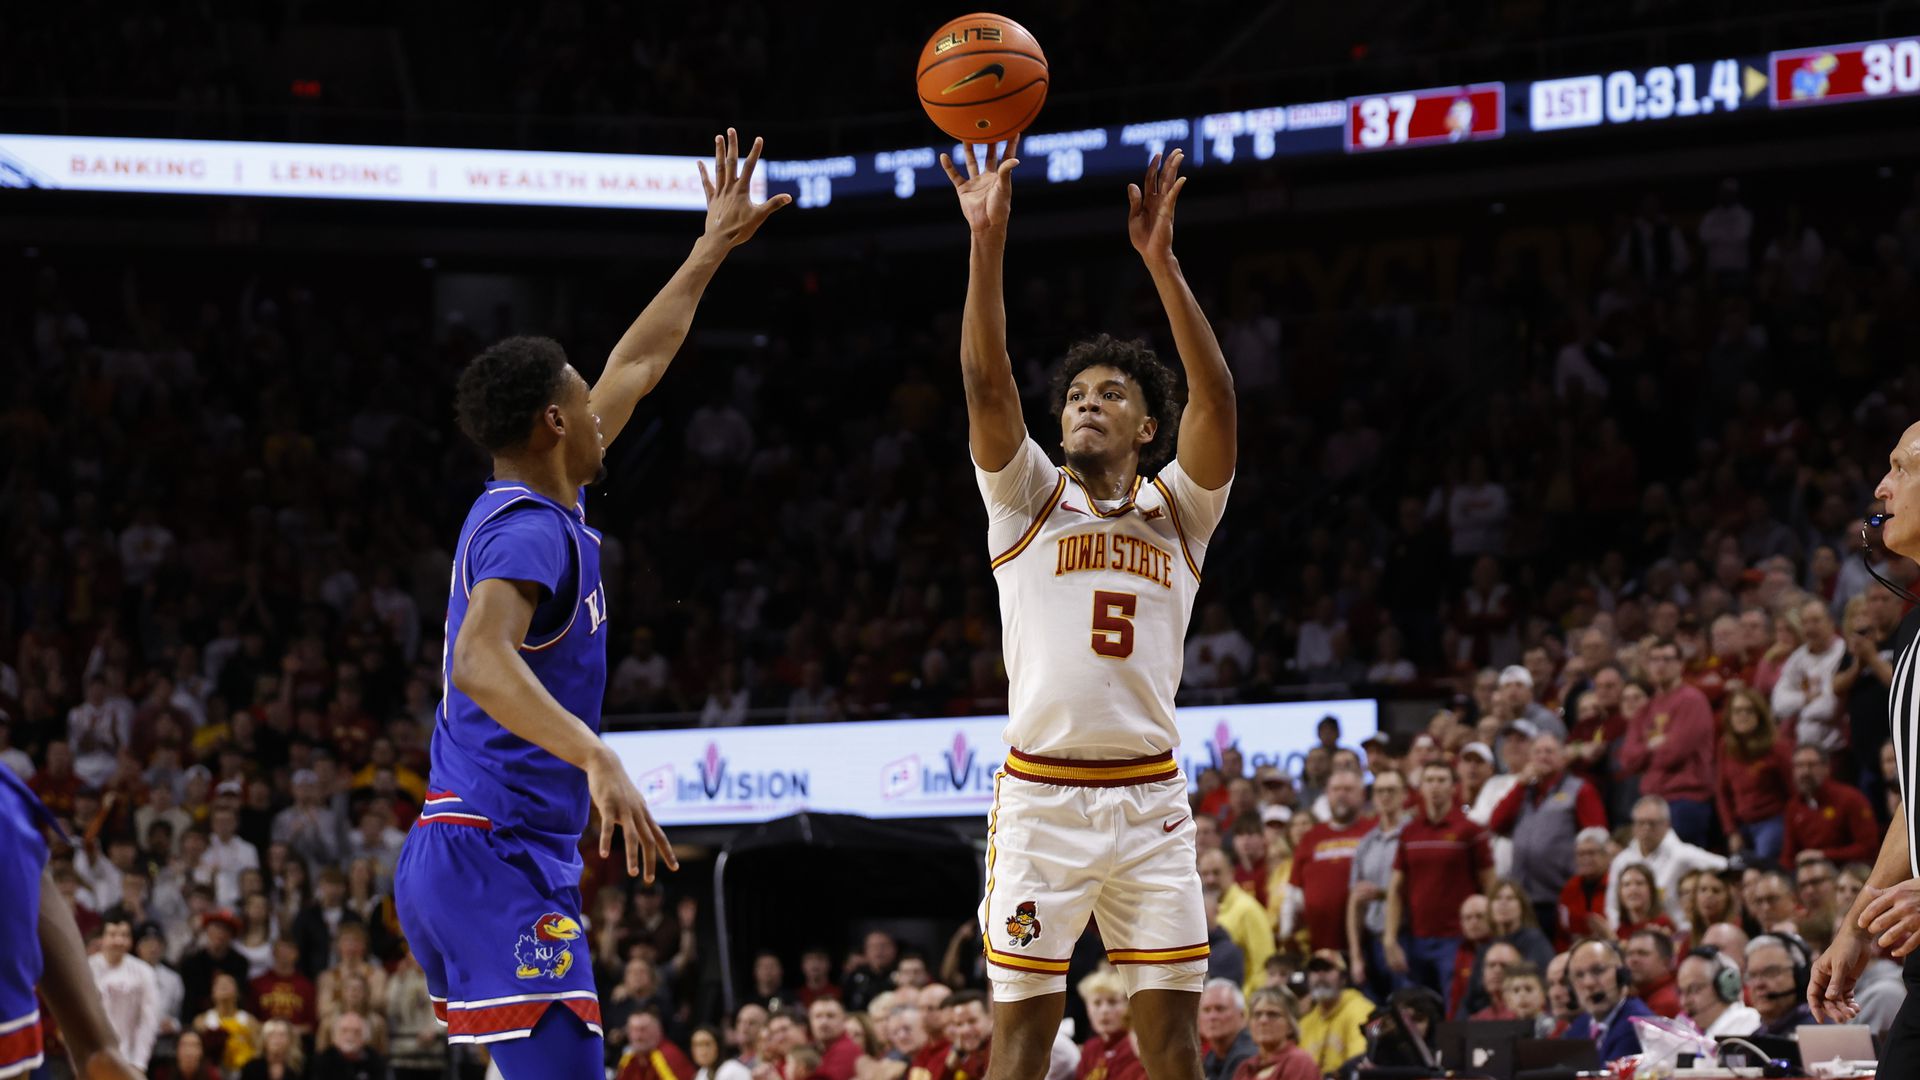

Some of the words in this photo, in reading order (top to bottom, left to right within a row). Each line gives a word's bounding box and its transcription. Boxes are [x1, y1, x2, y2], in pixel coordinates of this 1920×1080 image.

[935, 27, 1003, 54] ELITE
[1545, 86, 1589, 119] 1ST
[1605, 58, 1741, 123] 0:31.4
[1862, 41, 1920, 95] 30
[1359, 95, 1416, 147] 37
[71, 154, 207, 178] BANKING
[270, 159, 402, 185] LENDING
[467, 168, 588, 190] WEALTH
[1047, 149, 1083, 182] 20
[1055, 532, 1106, 577] IOWA
[1111, 533, 1172, 590] STATE
[1091, 590, 1137, 660] 5
[922, 749, 1000, 793] InVIS
[535, 947, 554, 960] KU
